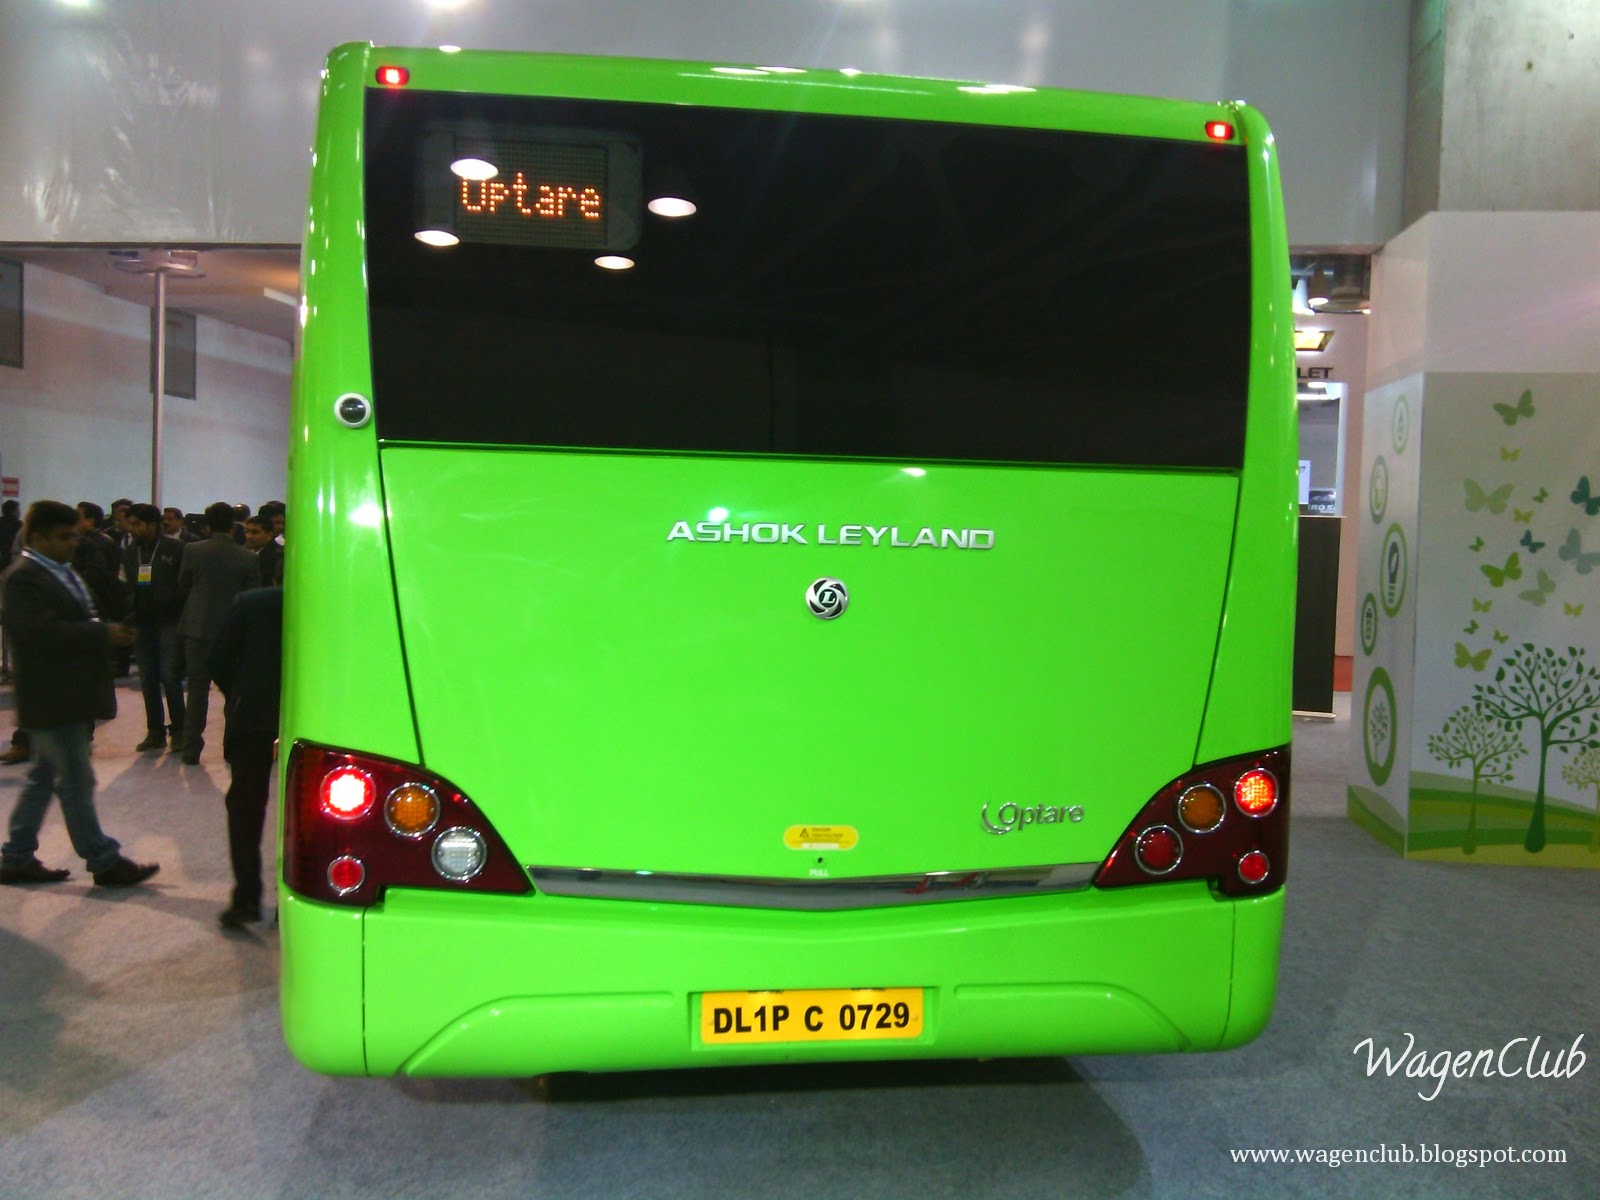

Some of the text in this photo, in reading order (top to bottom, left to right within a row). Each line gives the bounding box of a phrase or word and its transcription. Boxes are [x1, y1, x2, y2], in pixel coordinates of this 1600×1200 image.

[666, 520, 996, 551] ASHOK LEYLAND
[998, 801, 1085, 831] Optare
[713, 1001, 911, 1035] DL1P C 0729
